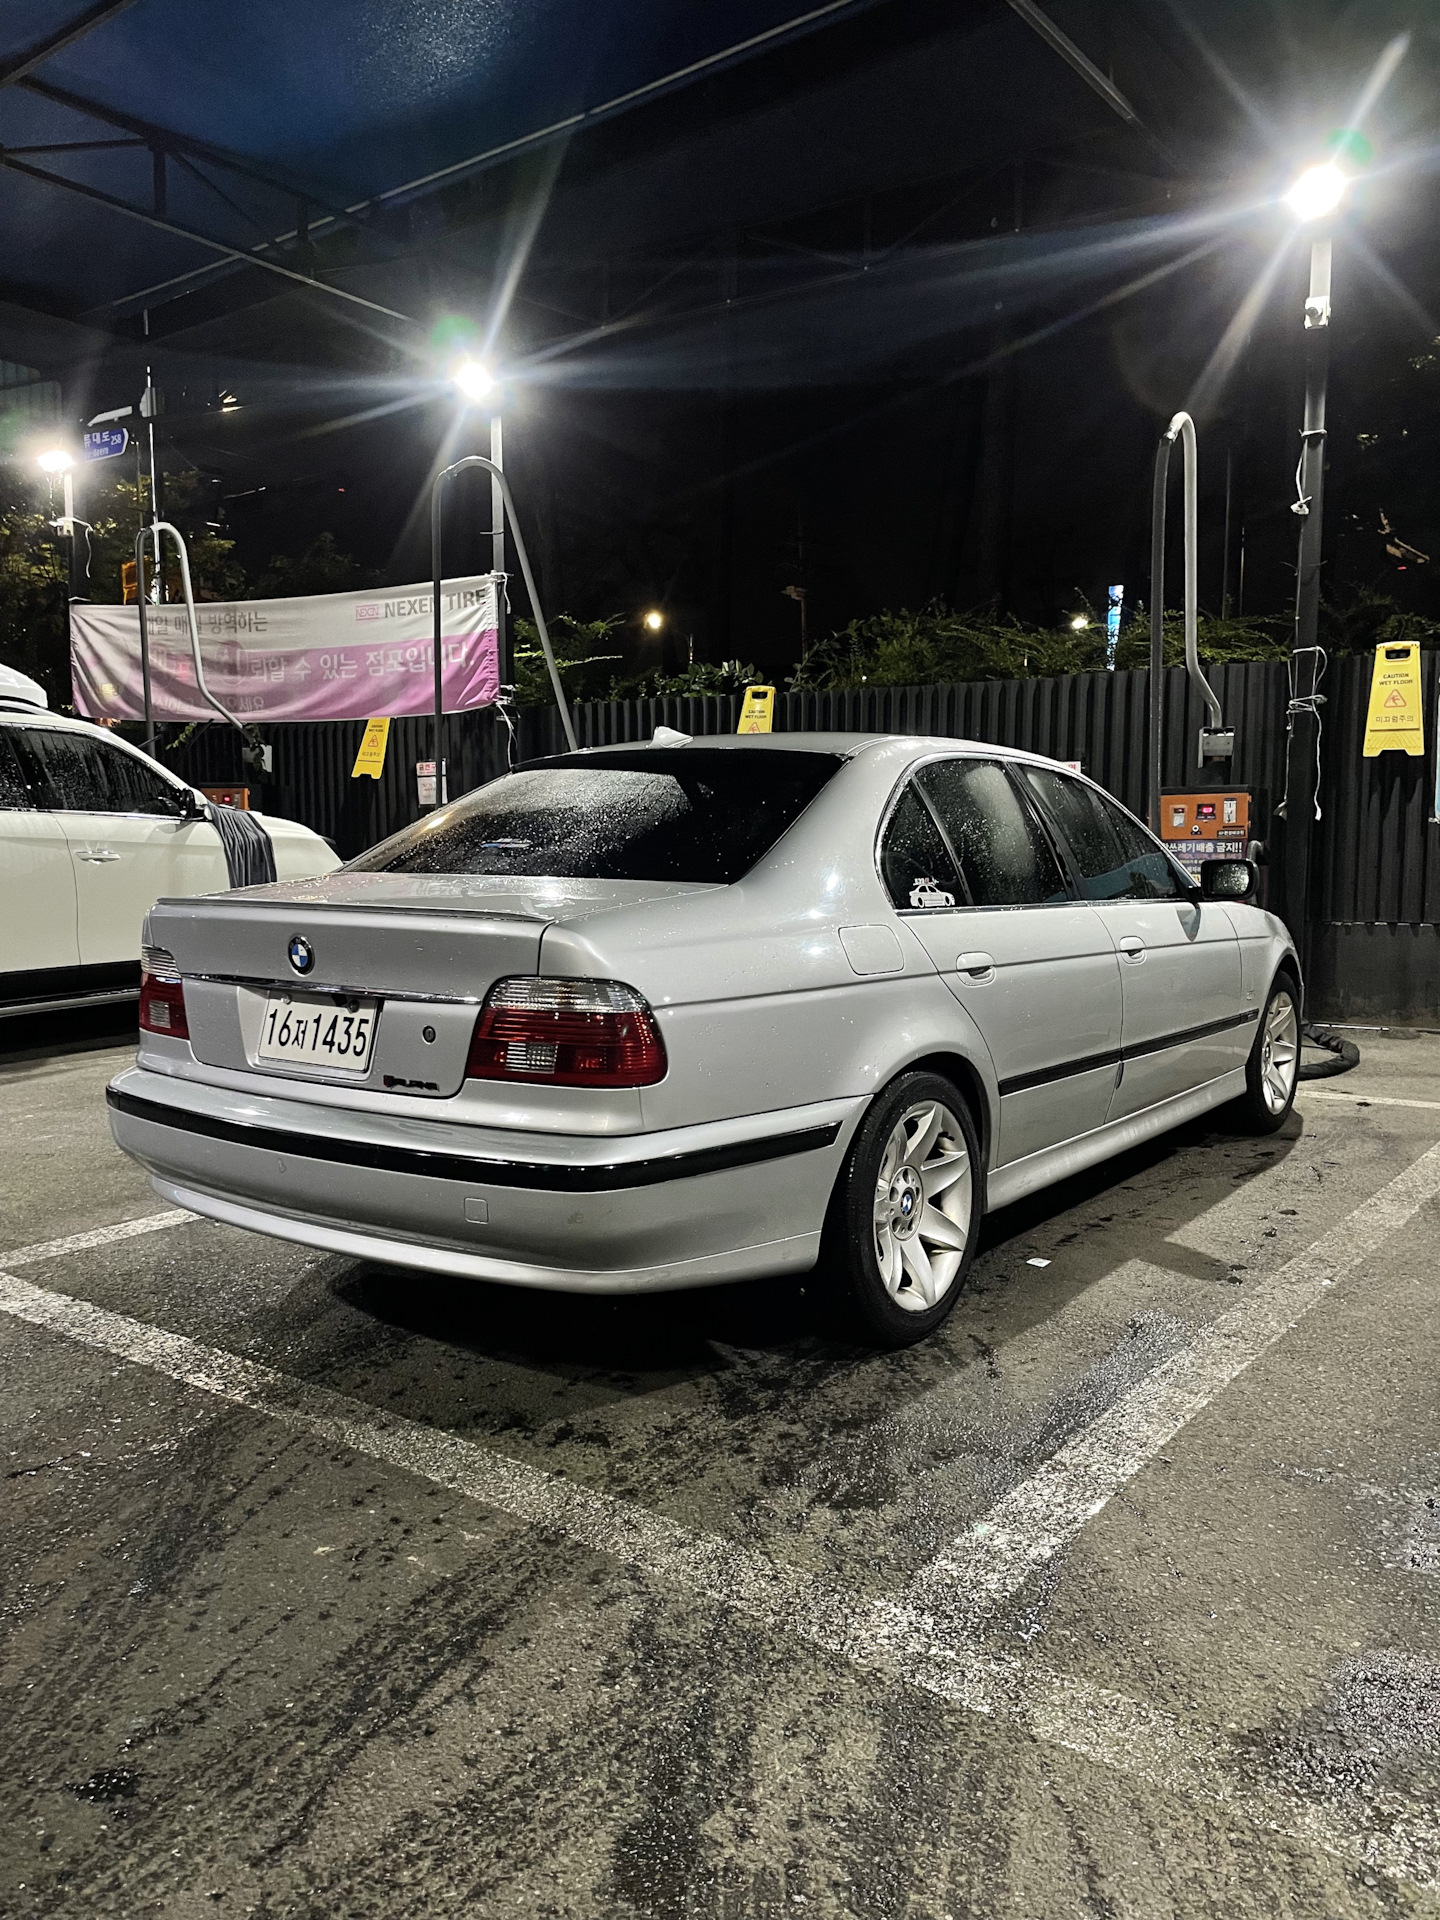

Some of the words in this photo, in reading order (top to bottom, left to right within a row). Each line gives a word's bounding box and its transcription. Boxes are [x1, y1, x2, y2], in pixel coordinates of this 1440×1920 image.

[111, 434, 122, 446] 258
[446, 588, 486, 611] TIRE
[208, 611, 268, 635] 방역하는
[294, 656, 311, 680] 수
[320, 653, 357, 679] 있는
[1216, 842, 1243, 853] 금지!!
[268, 1008, 369, 1056] 16저1435
